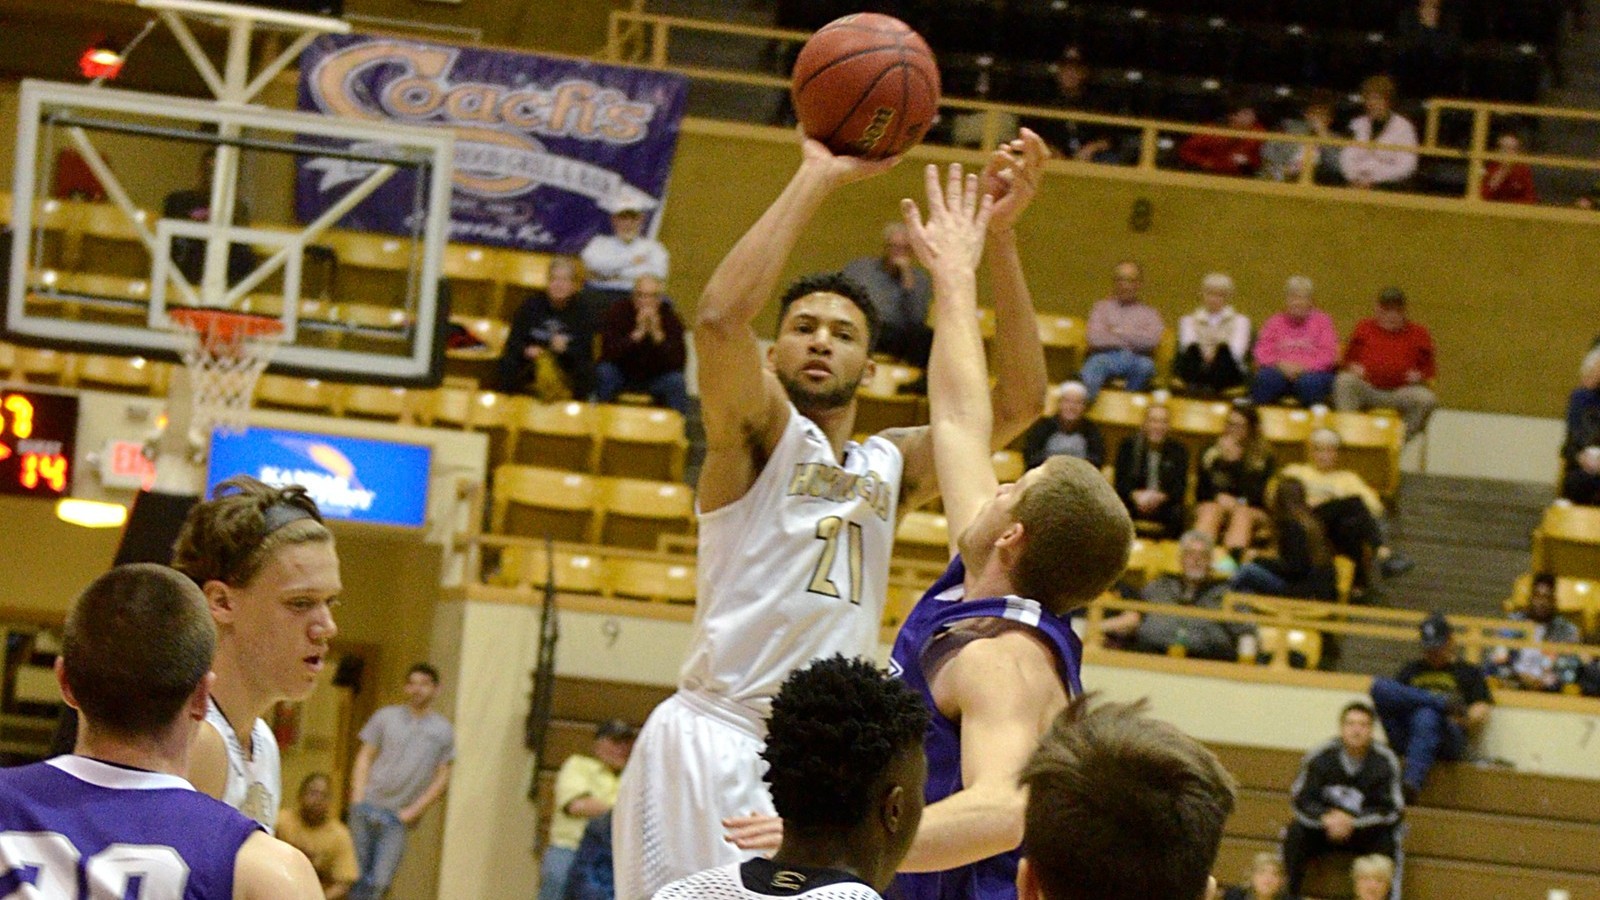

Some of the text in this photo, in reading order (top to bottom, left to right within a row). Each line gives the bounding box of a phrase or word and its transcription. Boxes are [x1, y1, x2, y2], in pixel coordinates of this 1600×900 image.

[309, 38, 655, 145] Coach's
[20, 452, 68, 492] 14
[806, 515, 864, 606] 21
[601, 618, 620, 650] 9
